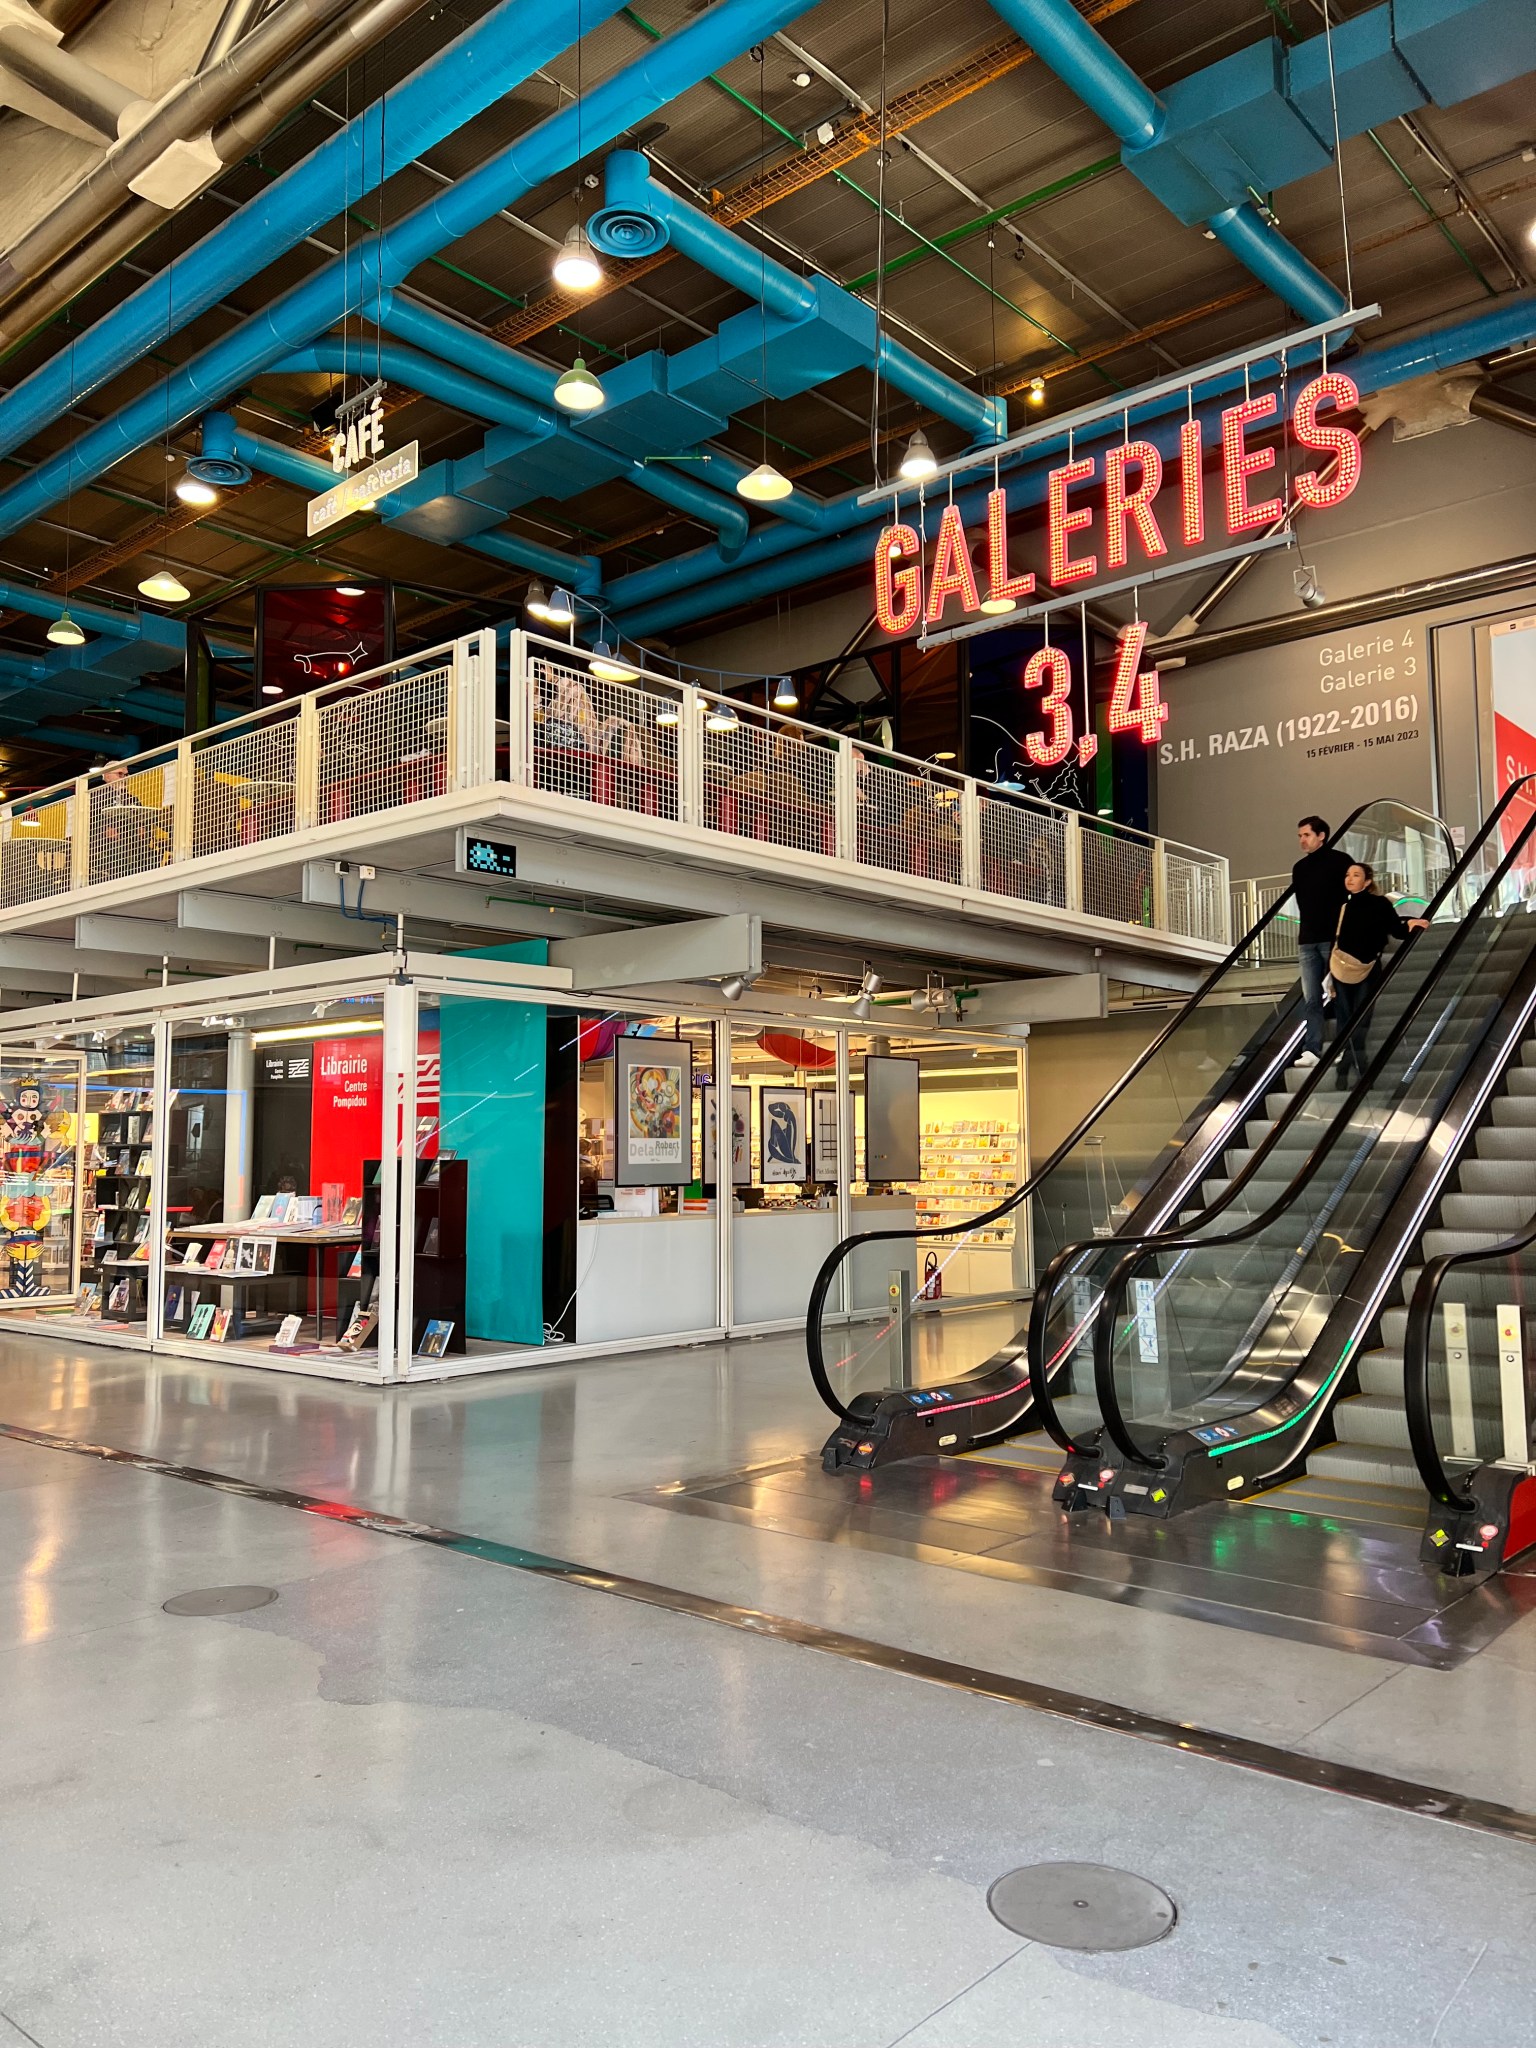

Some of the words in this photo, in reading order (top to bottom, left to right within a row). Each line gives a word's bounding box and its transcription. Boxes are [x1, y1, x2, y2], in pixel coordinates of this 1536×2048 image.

[332, 396, 385, 474] CAFÉ
[874, 371, 1363, 636] GALERIES
[1319, 635, 1394, 666] Galerie
[1401, 628, 1415, 648] 4
[1320, 663, 1395, 693] Galerie
[1404, 656, 1417, 676] 3
[1023, 620, 1169, 768] 3,4
[1160, 738, 1201, 765] S.H.
[1209, 724, 1270, 756] RAZA
[1276, 694, 1419, 748] (1922-2016)
[1306, 749, 1316, 758] 15
[1318, 740, 1354, 757] FÉVRIER
[1363, 738, 1374, 748] 15
[1376, 734, 1394, 746] MAI
[1396, 729, 1419, 742] 2023
[321, 1054, 368, 1076] Librairie
[333, 1095, 368, 1110] Pompidou
[344, 1080, 368, 1093] Centre
[655, 1140, 680, 1149] Robert
